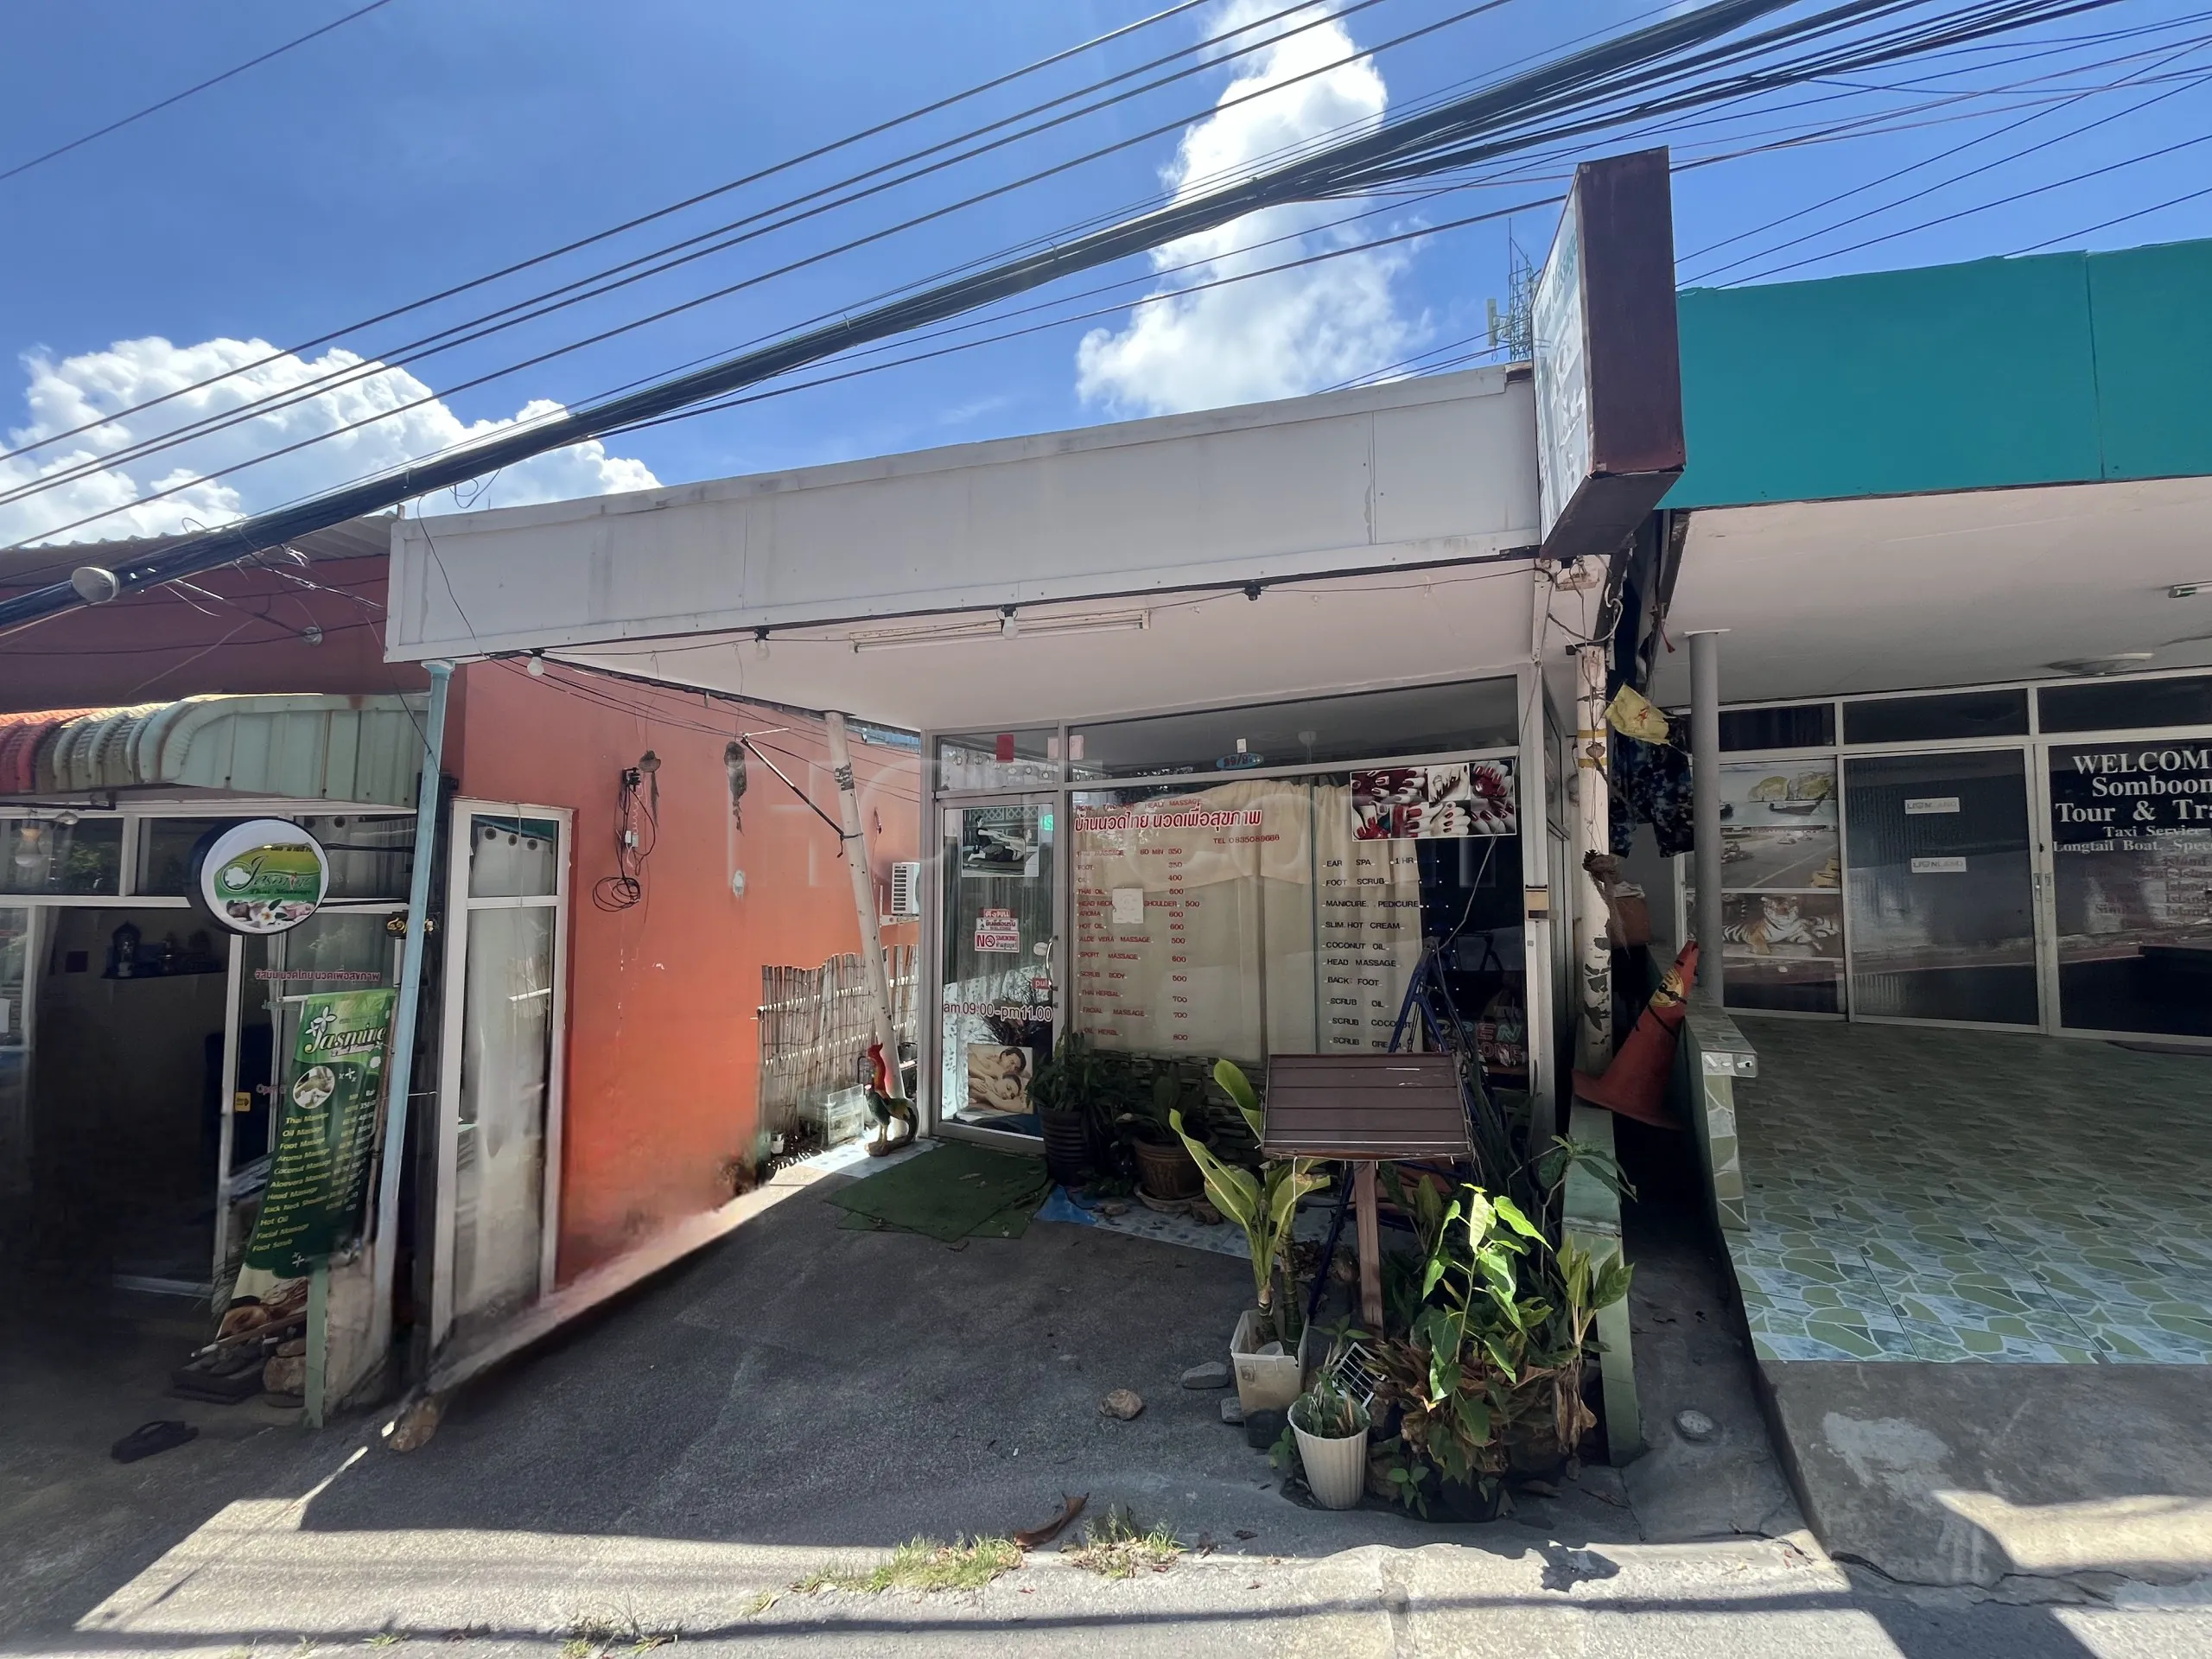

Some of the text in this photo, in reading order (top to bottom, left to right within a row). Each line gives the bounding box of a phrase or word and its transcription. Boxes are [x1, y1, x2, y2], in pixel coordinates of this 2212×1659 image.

[2055, 799, 2212, 823] Tour & Tr
[1153, 800, 1262, 833] นวดเพื่อสุขภาพ
[2102, 826, 2138, 837] Taxi
[2053, 840, 2114, 855] Longtail
[2173, 838, 2212, 854] Spee
[1357, 877, 1385, 886] SCRUB
[1370, 921, 1401, 930] CREAM
[1325, 941, 1366, 950] COCONUT
[1357, 978, 1380, 987] FOOT
[1330, 997, 1357, 1006] SCRUB
[1113, 1008, 1145, 1017] MASSAGE
[1332, 1017, 1413, 1029] SCRUB COCOUT
[304, 1023, 387, 1054] Jasmine
[1332, 1037, 1359, 1046] SCRUB
